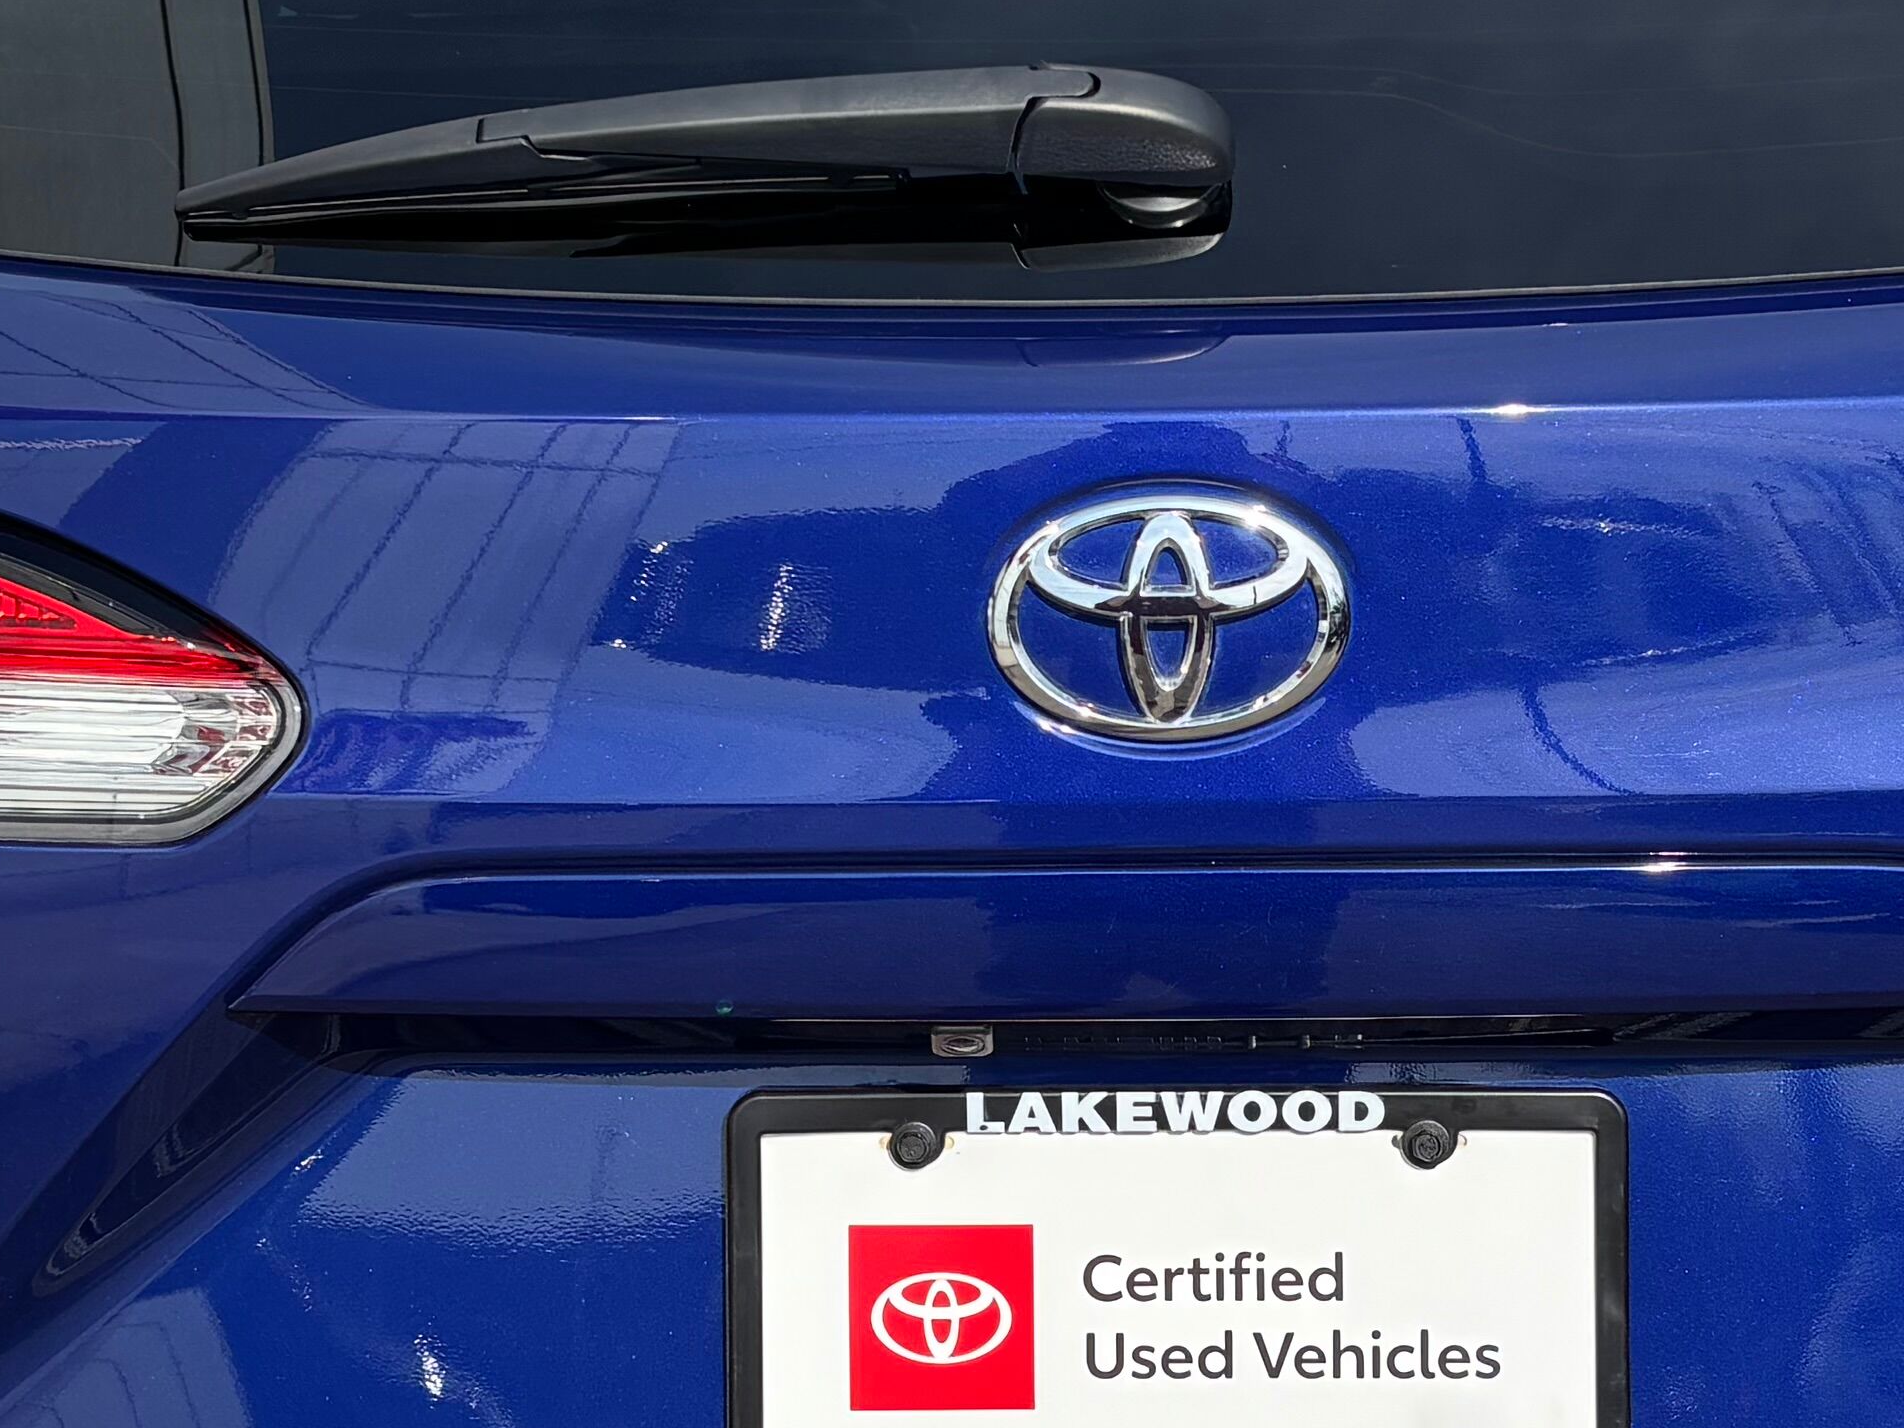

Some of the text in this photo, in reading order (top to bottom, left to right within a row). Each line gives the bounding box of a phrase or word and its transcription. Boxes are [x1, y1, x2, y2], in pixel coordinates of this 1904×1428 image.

[965, 1091, 1386, 1134] LAKEWOOD
[1081, 1252, 1345, 1303] Certified
[1083, 1330, 1502, 1381] Used Vehicles
